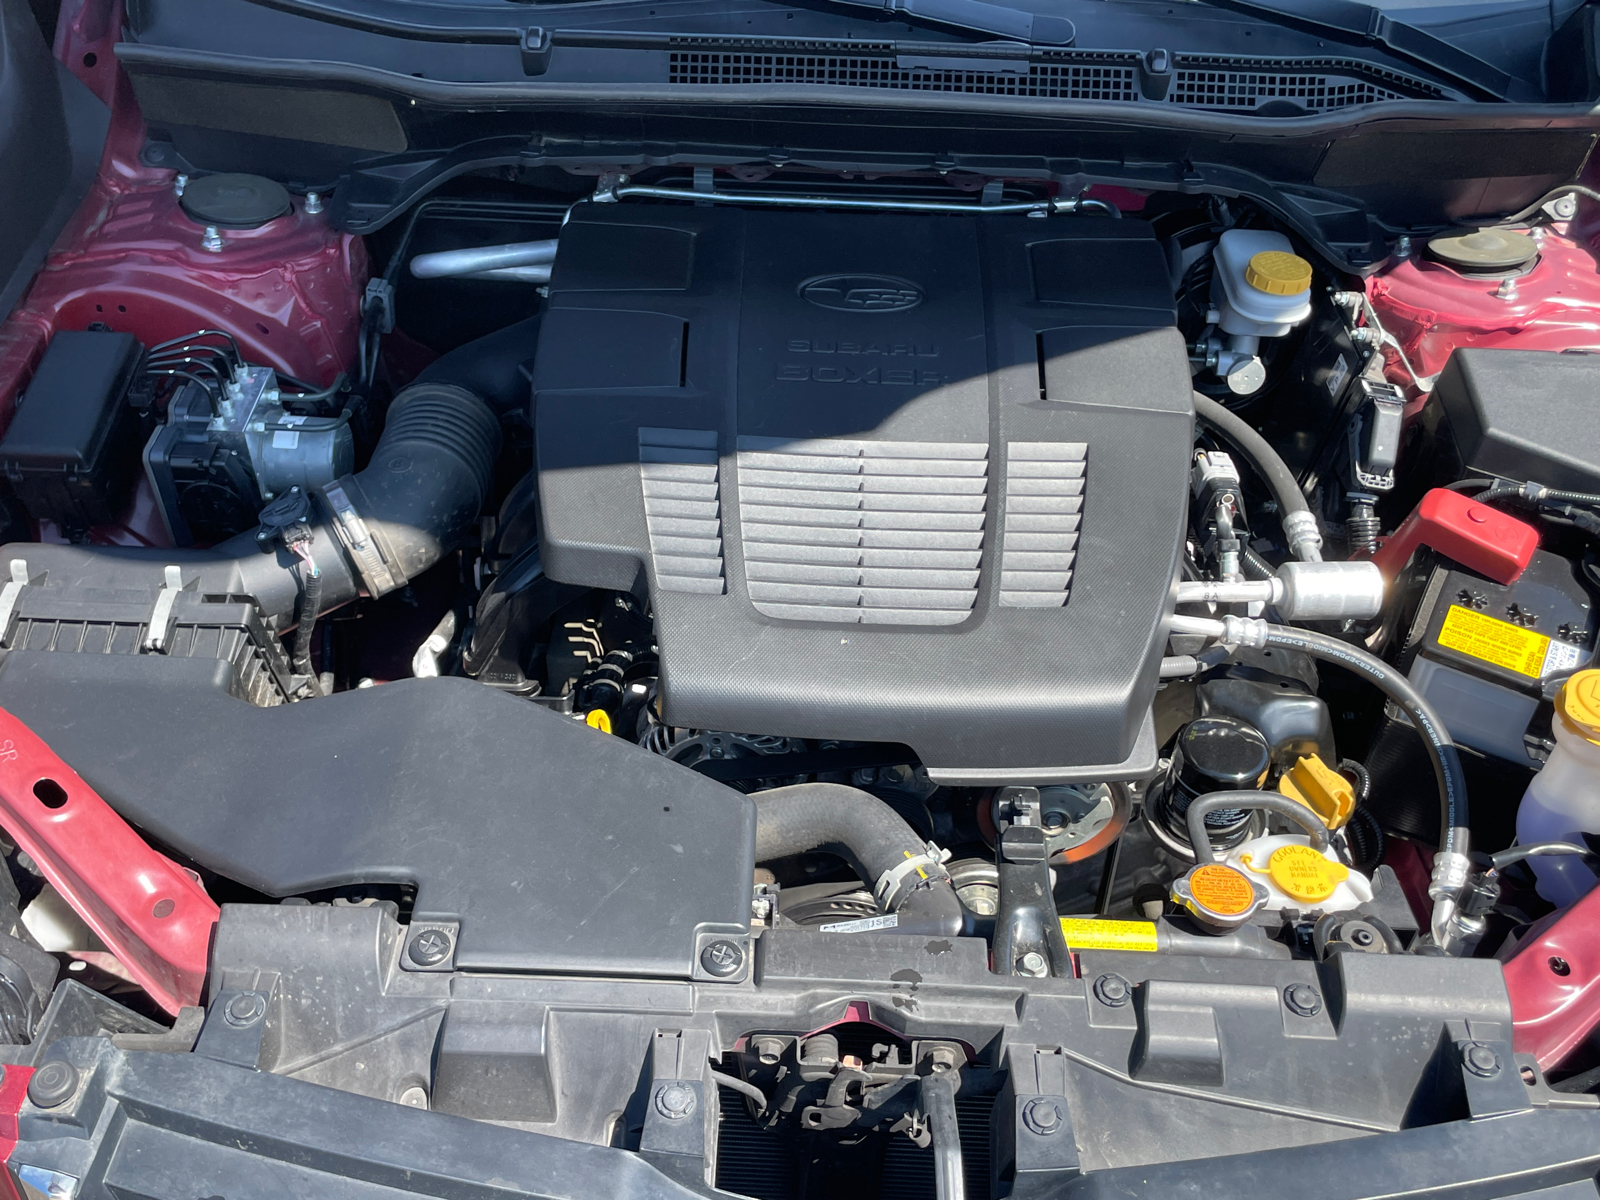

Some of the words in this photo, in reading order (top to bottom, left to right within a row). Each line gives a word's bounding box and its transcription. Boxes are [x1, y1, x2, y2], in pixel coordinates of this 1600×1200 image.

[786, 340, 940, 357] SUBARU
[776, 365, 941, 386] BOXER
[1452, 607, 1480, 620] DANGER
[1444, 627, 1473, 640] POISON
[1272, 846, 1327, 863] COOLANT
